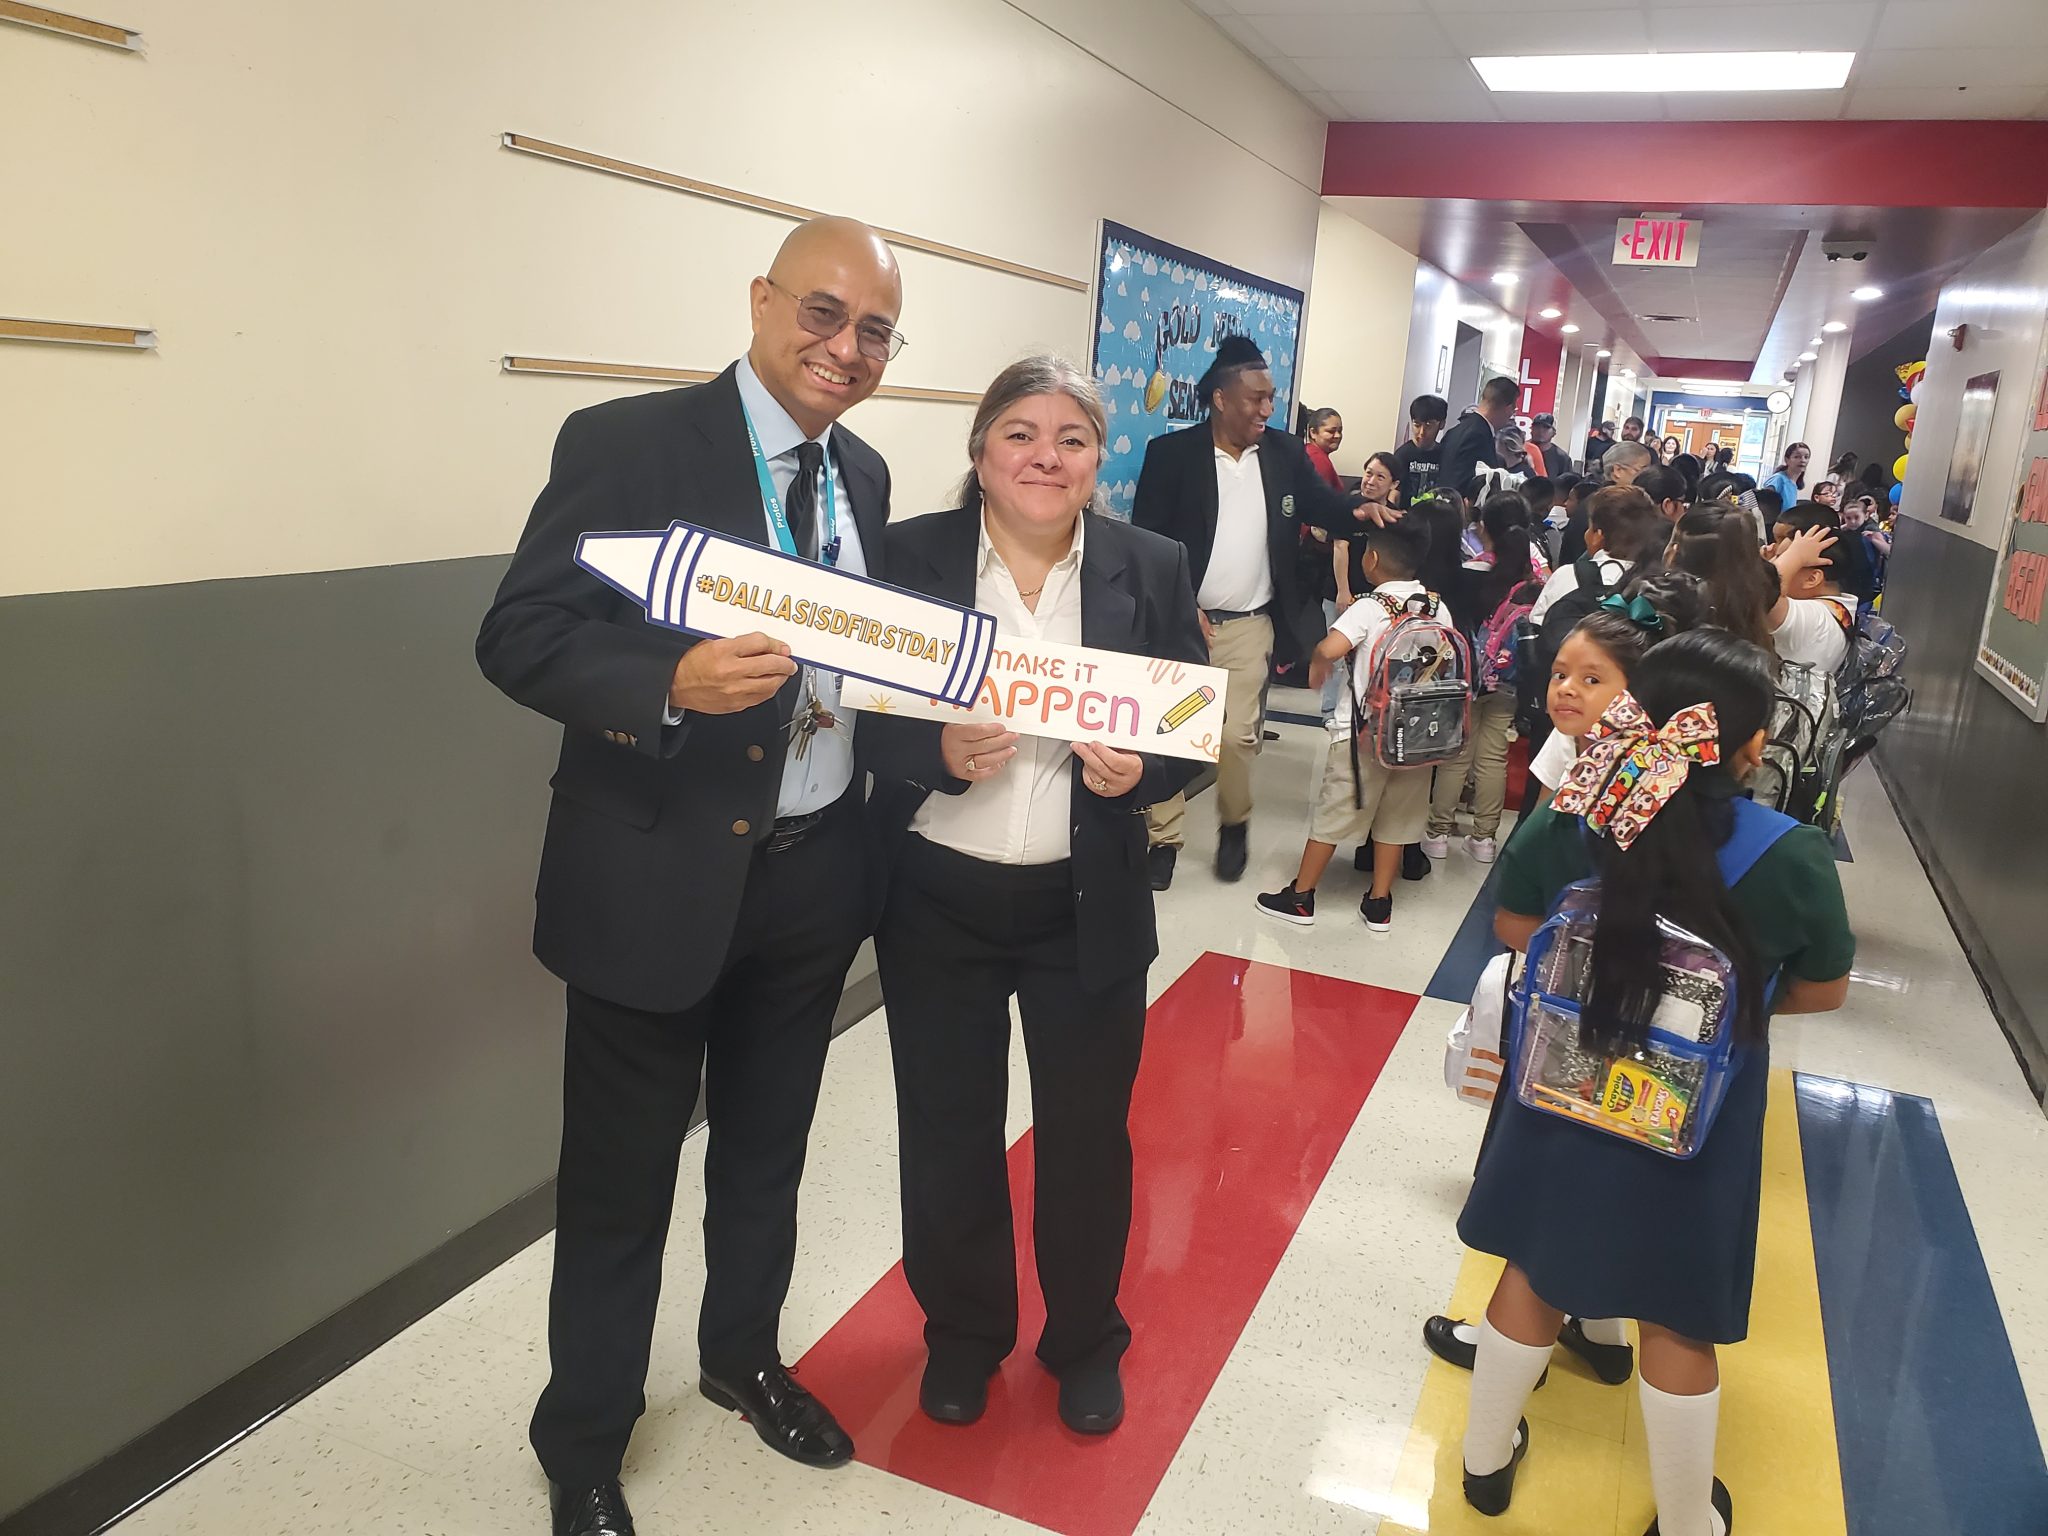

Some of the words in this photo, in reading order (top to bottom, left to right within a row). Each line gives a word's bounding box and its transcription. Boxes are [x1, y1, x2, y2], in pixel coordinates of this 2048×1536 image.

[1631, 221, 1689, 260] EXIT
[1157, 305, 1201, 352] GOLD
[770, 498, 785, 529] Protos
[696, 575, 955, 665] #DALLASISDFIRSTDAY
[930, 676, 1140, 737] APPEN
[1607, 1074, 1623, 1109] Crayola
[1650, 1087, 1670, 1127] CRAYONS
